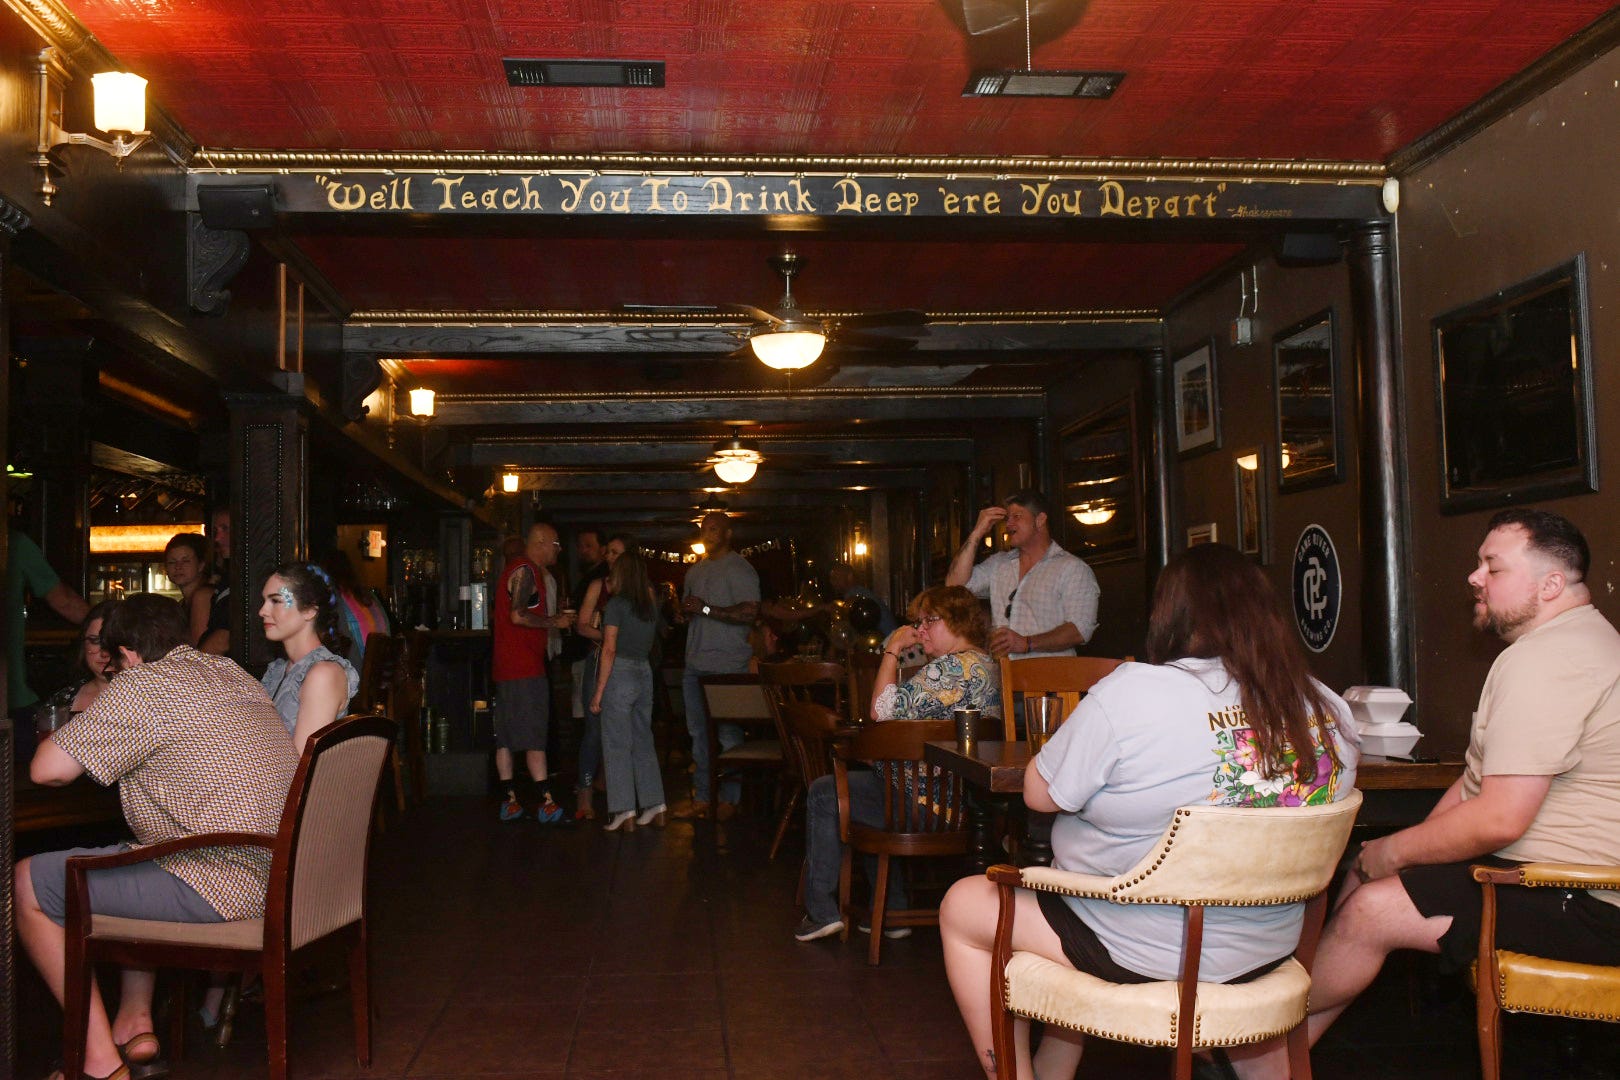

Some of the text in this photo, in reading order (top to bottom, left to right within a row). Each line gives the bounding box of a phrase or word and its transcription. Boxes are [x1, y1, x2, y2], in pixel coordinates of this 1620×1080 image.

[315, 174, 1227, 219] "We'll Teach You To Drink Deep 'ere You Depart"
[1208, 711, 1250, 731] NUR
